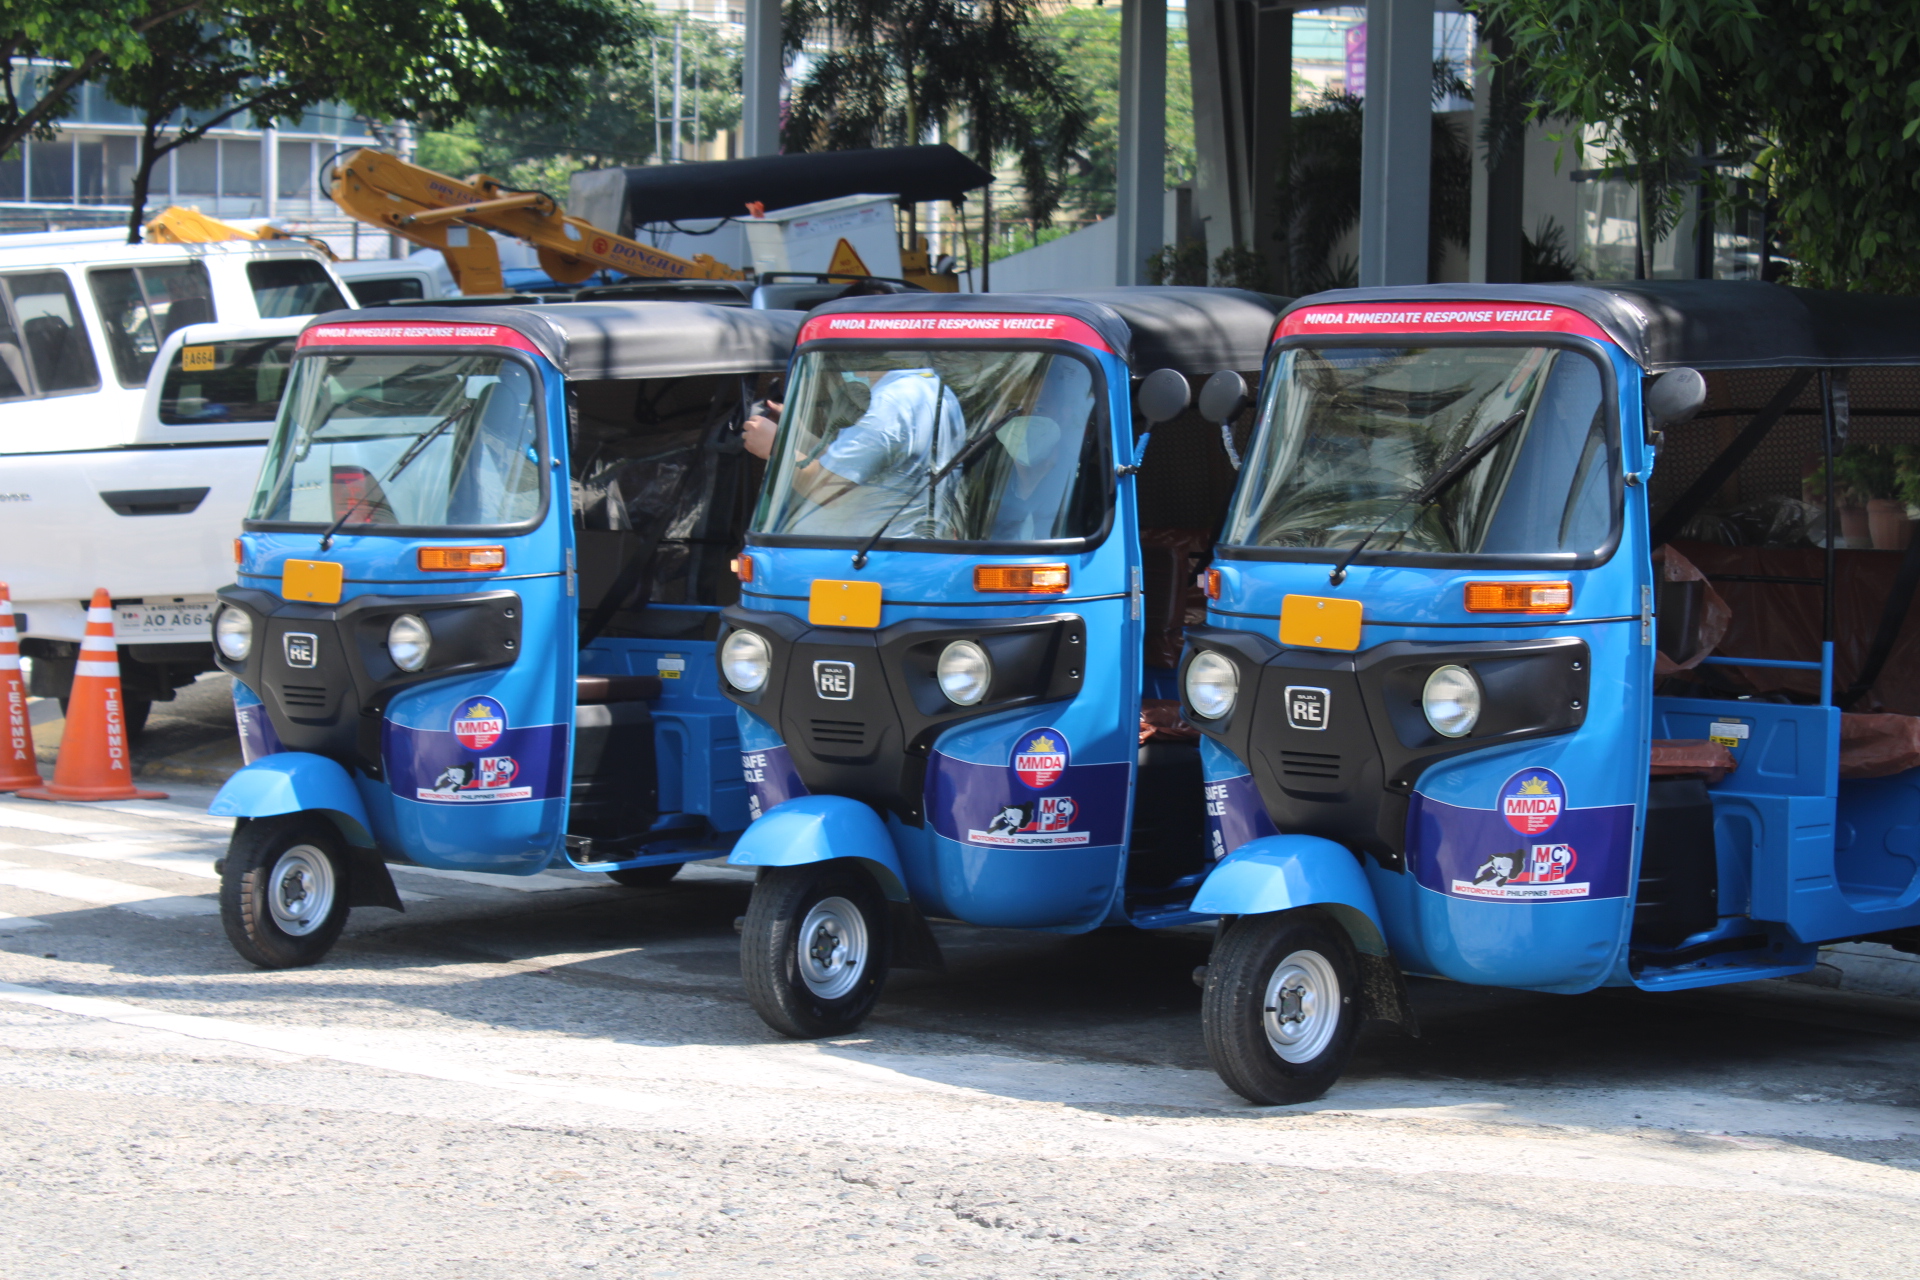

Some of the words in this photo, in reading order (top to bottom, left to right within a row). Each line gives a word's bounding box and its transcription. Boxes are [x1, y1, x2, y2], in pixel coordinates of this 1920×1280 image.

[1304, 313, 1343, 324] MMDA
[1345, 312, 1422, 323] IMMEDIATE
[1423, 311, 1493, 323] RESPONSE
[1495, 310, 1553, 321] VEHICLE
[829, 319, 866, 329] MMDA
[867, 319, 936, 329] IMMEDIATE
[937, 319, 1000, 329] RESPONSE
[1002, 319, 1055, 329] VEHICLE
[316, 328, 346, 337] MMDA
[347, 327, 403, 337] IMMEDIATE
[403, 327, 454, 337] RESPONSE
[455, 327, 498, 337] VEHICLE
[190, 352, 213, 364] A664
[143, 614, 166, 626] AO
[290, 645, 311, 661] RE
[821, 674, 848, 693] RE
[1293, 700, 1322, 722] RE
[457, 721, 500, 733] MMDA
[1017, 756, 1062, 769] MMDA
[1506, 799, 1557, 814] MMDA
[971, 833, 1015, 844] MOTORCYCLE
[1017, 837, 1053, 845] PHILIPPINES
[1054, 836, 1087, 844] FEDERATION
[1455, 884, 1505, 897] MOTORCYCLE
[1506, 889, 1548, 897] PHILIPPINES
[1549, 887, 1587, 896] FEDERATION
